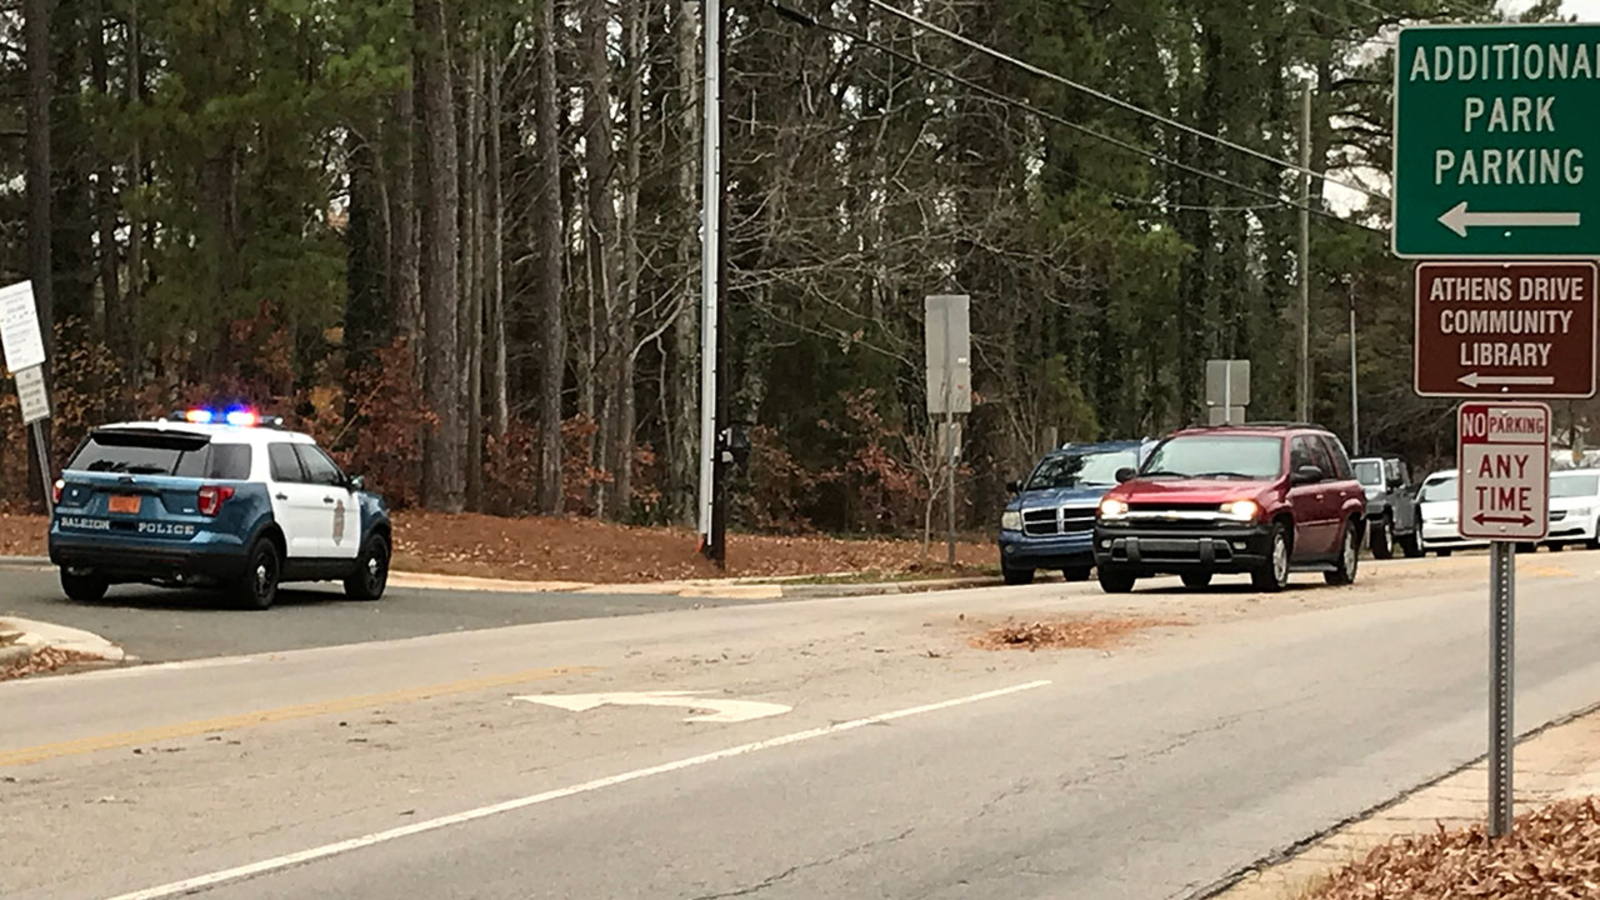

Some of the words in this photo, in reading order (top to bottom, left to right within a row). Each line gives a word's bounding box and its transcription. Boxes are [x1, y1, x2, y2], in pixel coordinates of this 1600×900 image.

[1409, 43, 1600, 82] ADDITIONA
[1464, 96, 1556, 133] PARK
[1434, 148, 1584, 185] PARKING
[1429, 277, 1513, 301] ATHENS
[1519, 277, 1584, 301] DRIVE
[1440, 309, 1574, 334] COMMUNITY
[1460, 342, 1552, 367] LIBRARY
[1462, 412, 1486, 438] NO
[1489, 416, 1545, 434] PARKING
[1478, 453, 1529, 479] ANY
[1474, 485, 1532, 512] TIME
[61, 516, 111, 530] RALEIGH
[138, 521, 196, 535] POLICE
